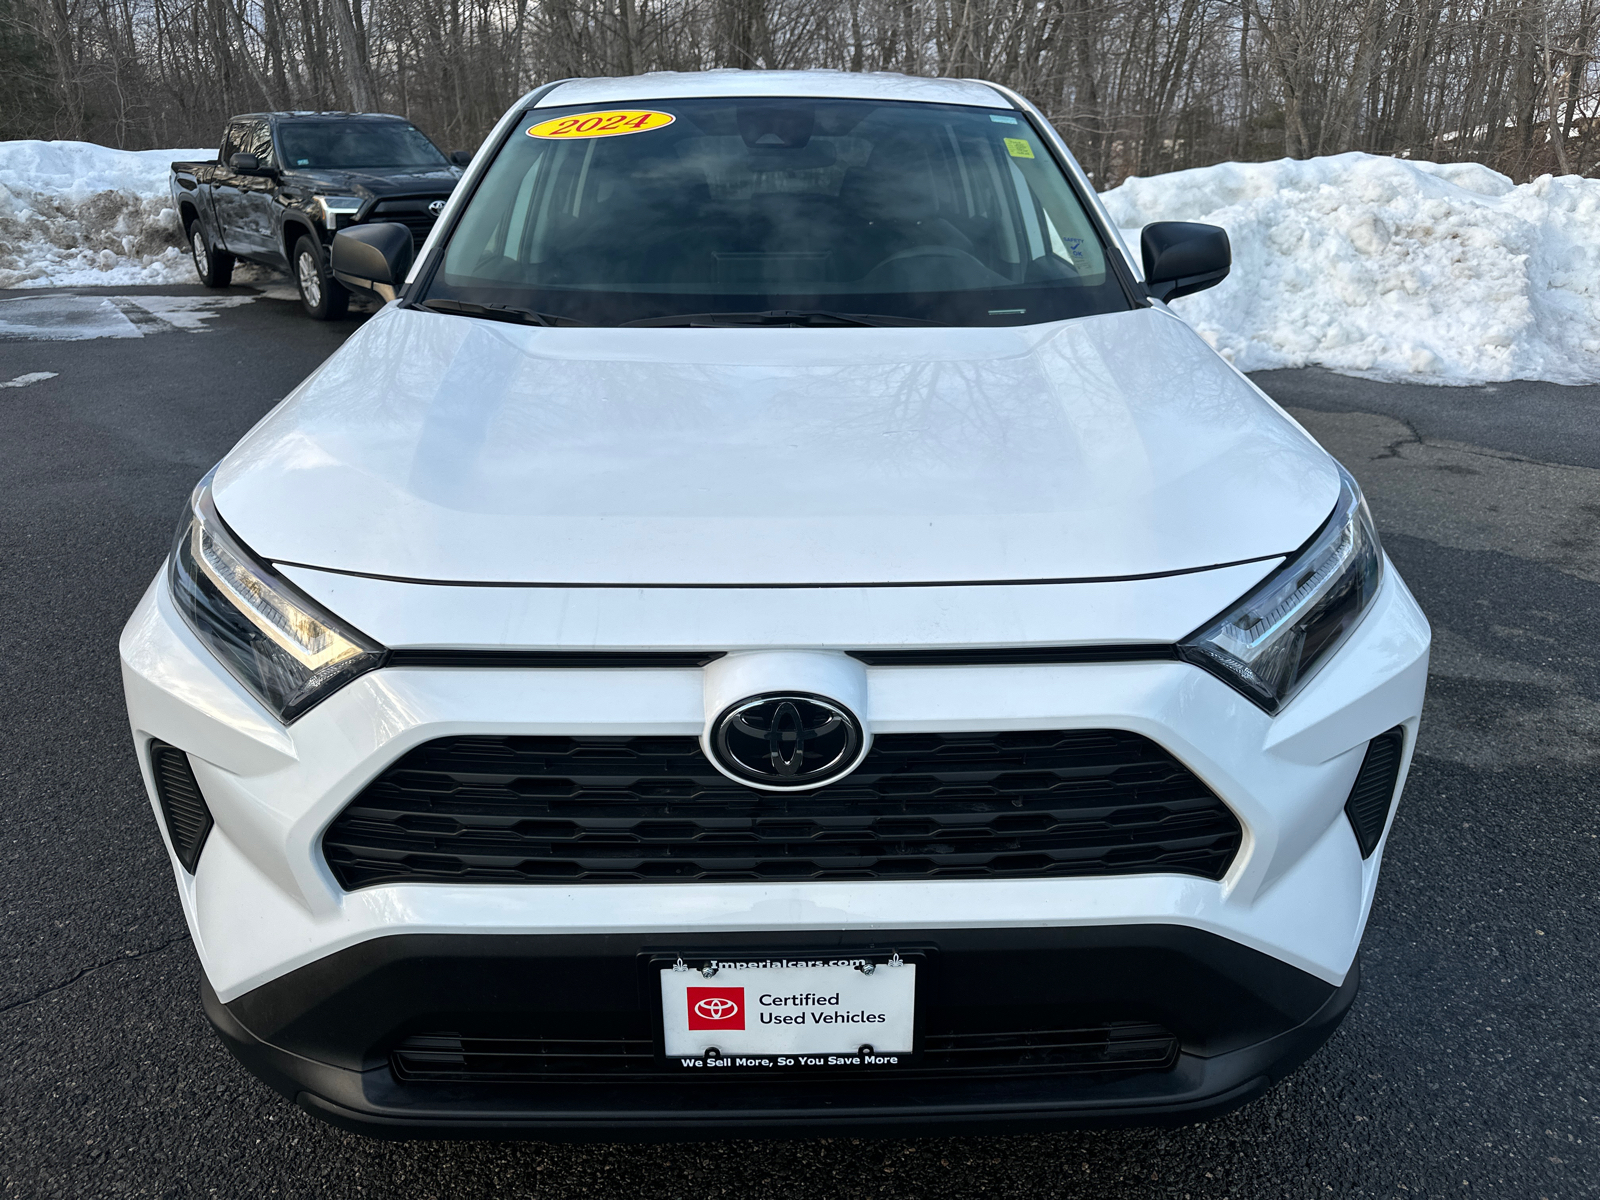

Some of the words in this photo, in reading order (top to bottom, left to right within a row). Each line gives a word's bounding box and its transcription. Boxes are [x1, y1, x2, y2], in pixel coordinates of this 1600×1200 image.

[549, 113, 652, 136] 2024
[710, 959, 866, 970] Imperialcars.com
[759, 992, 840, 1007] Certified
[760, 1011, 806, 1025] Used
[810, 1010, 886, 1024] Vehicles
[681, 1058, 703, 1068] We
[706, 1057, 731, 1068] Sell
[735, 1057, 774, 1068] More,
[777, 1056, 795, 1067] So
[798, 1056, 824, 1066] You
[828, 1055, 861, 1066] Save
[864, 1055, 898, 1065] More
